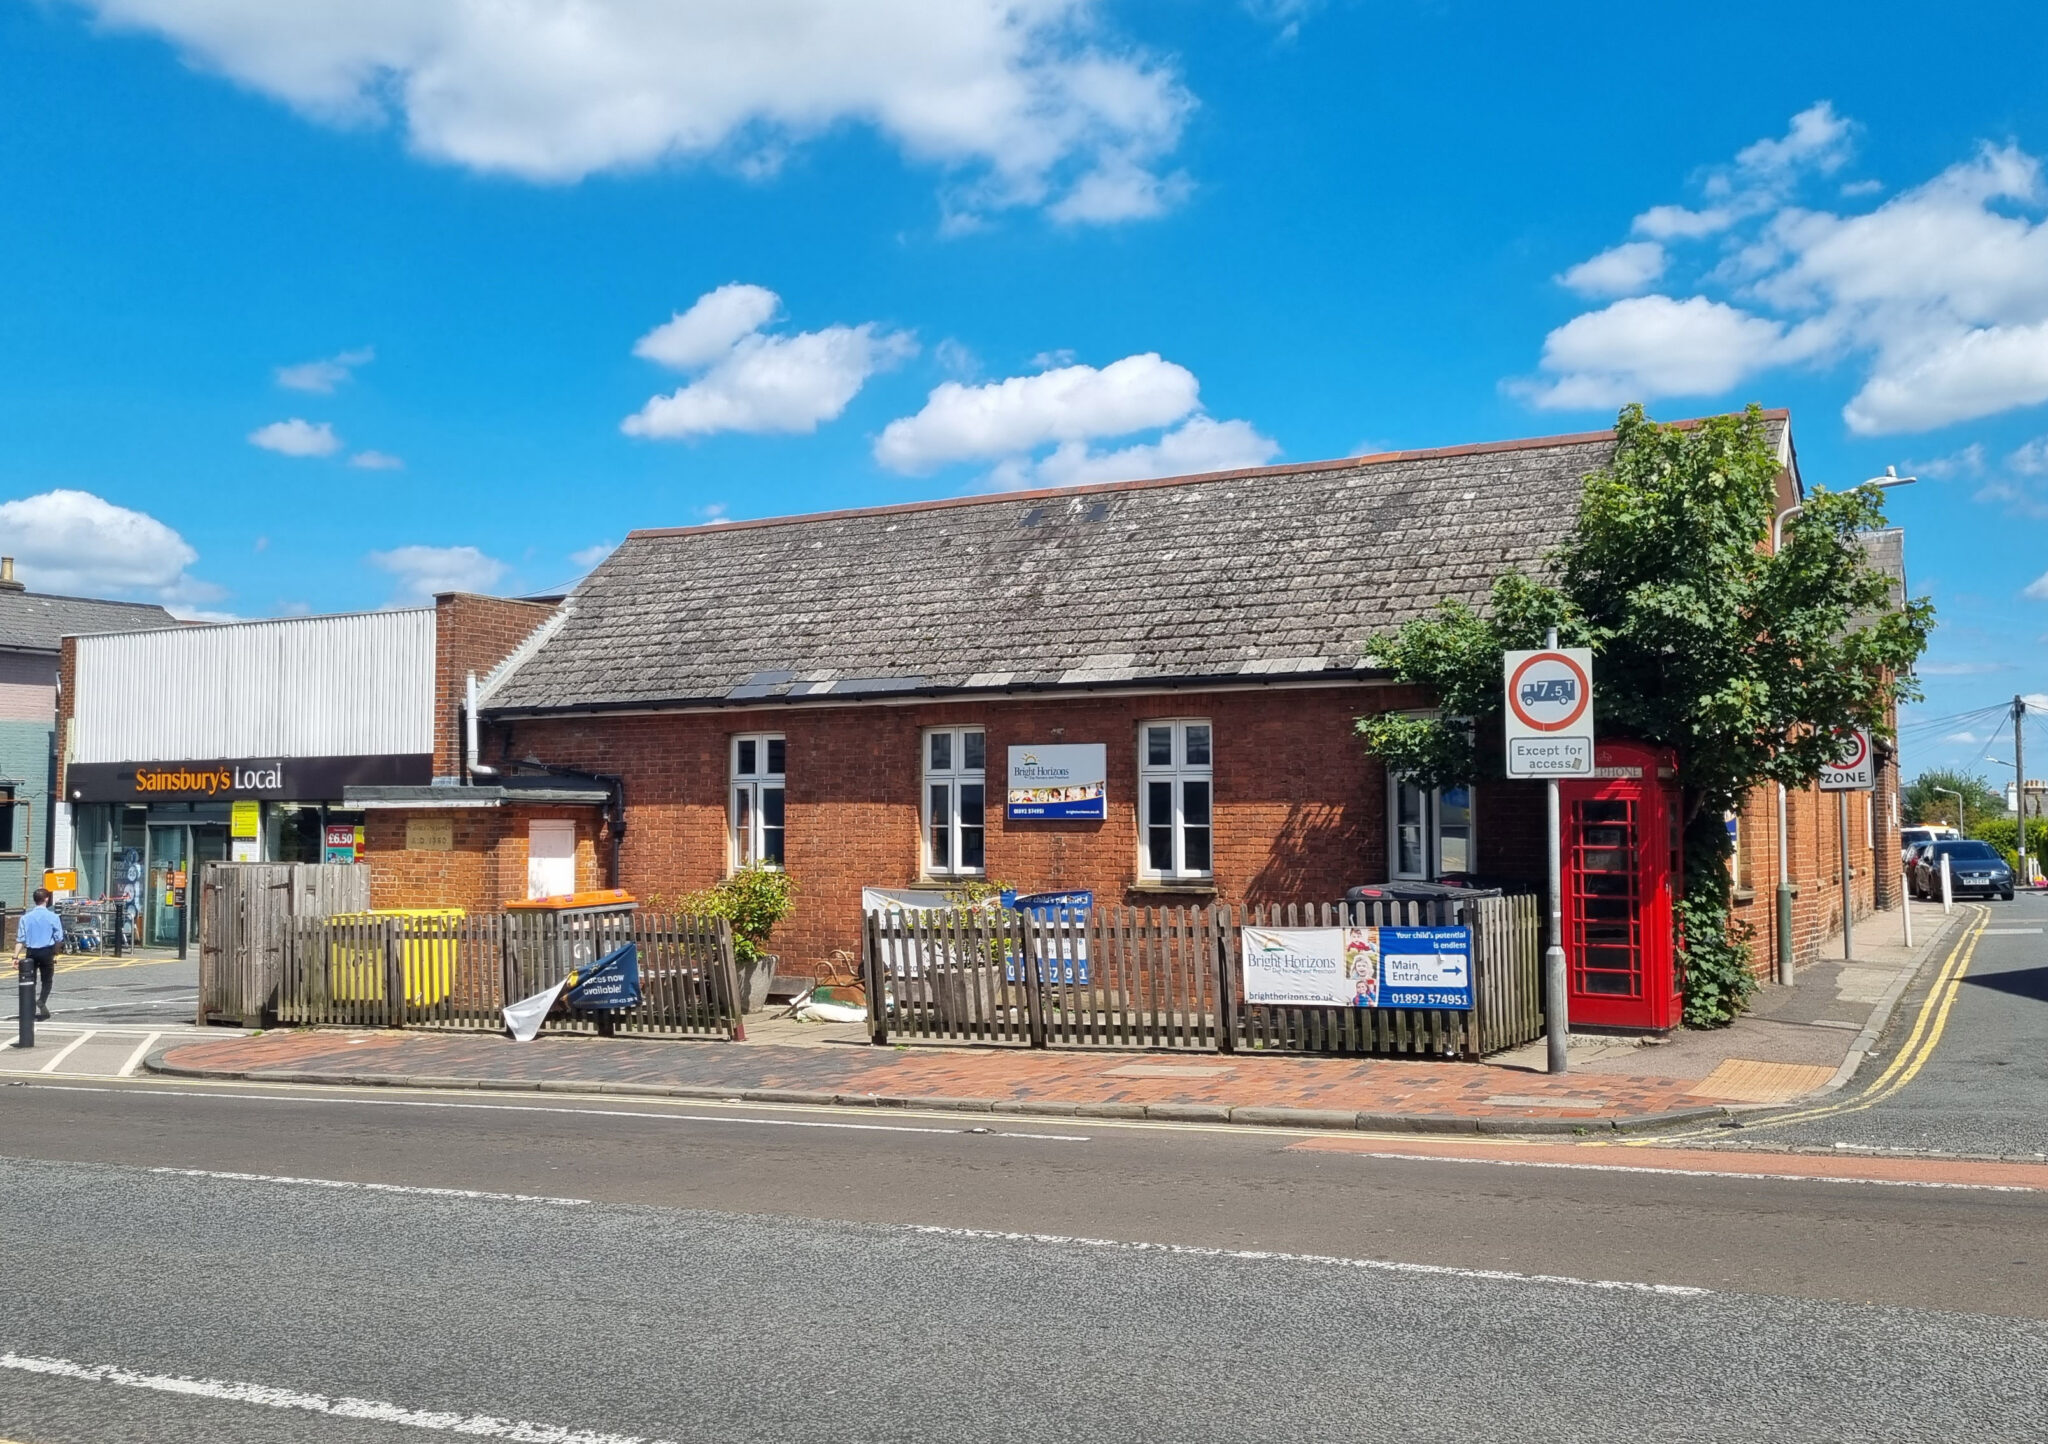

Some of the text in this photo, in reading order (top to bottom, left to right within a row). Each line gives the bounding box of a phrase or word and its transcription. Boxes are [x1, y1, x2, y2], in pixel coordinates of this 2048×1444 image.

[1517, 745, 1582, 757] Except for
[1529, 760, 1572, 769] access
[1014, 766, 1035, 778] Bright
[1037, 766, 1070, 776] Horizons
[136, 763, 282, 795] Sainsbury's Local
[1825, 772, 1866, 784] ZONE
[328, 832, 353, 844] £6.50
[1396, 931, 1466, 940] Your child's potential
[1440, 941, 1466, 949] endless
[1248, 953, 1336, 971] Bright Horizons
[1391, 960, 1418, 970] Main
[607, 974, 625, 983] now
[1392, 972, 1438, 981] Entrance
[583, 984, 622, 995] available!
[1249, 992, 1333, 1001] brighthorizons.co.uk
[1391, 993, 1468, 1005] 01892 574951
